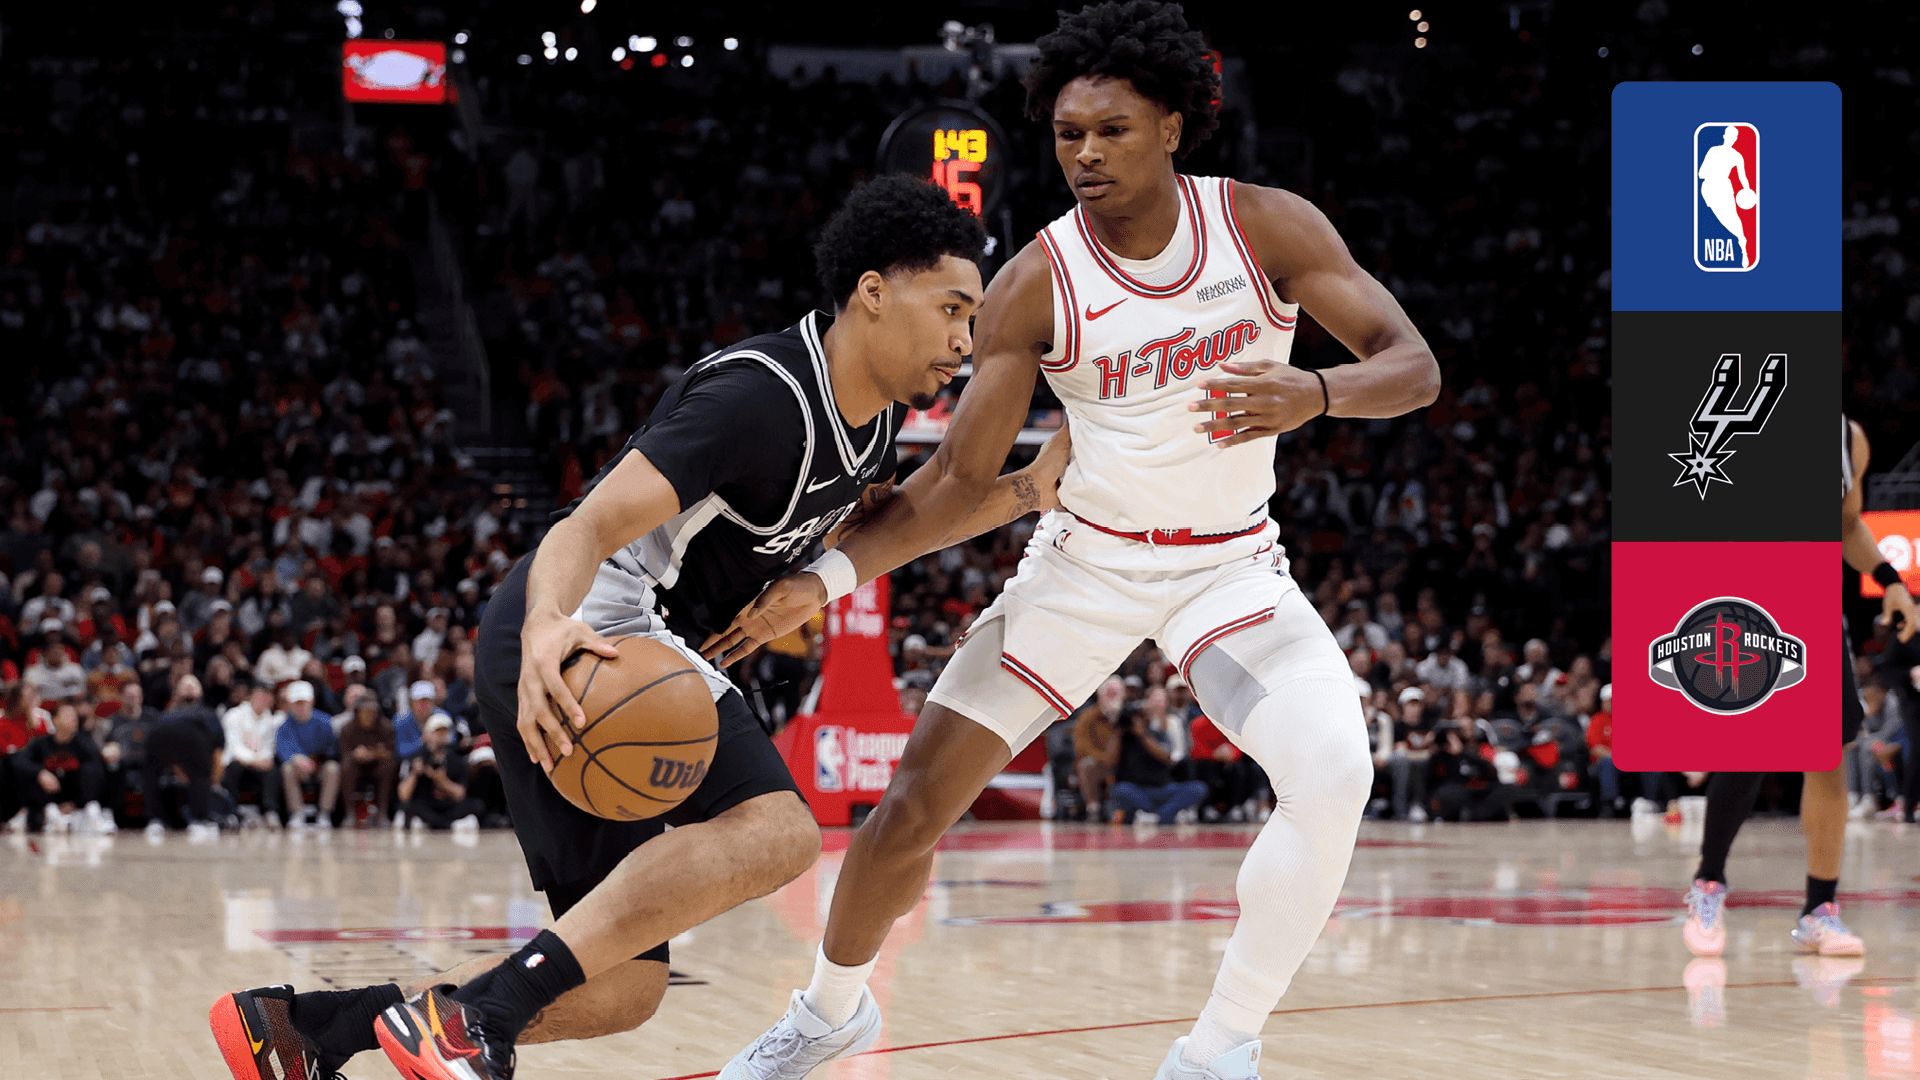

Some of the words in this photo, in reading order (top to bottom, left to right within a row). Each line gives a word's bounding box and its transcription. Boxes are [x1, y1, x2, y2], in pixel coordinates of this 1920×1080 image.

[1196, 274, 1243, 298] MEMORIAL
[1198, 279, 1247, 303] HERMANN
[1092, 319, 1261, 400] H-Town
[753, 498, 859, 564] SPUR
